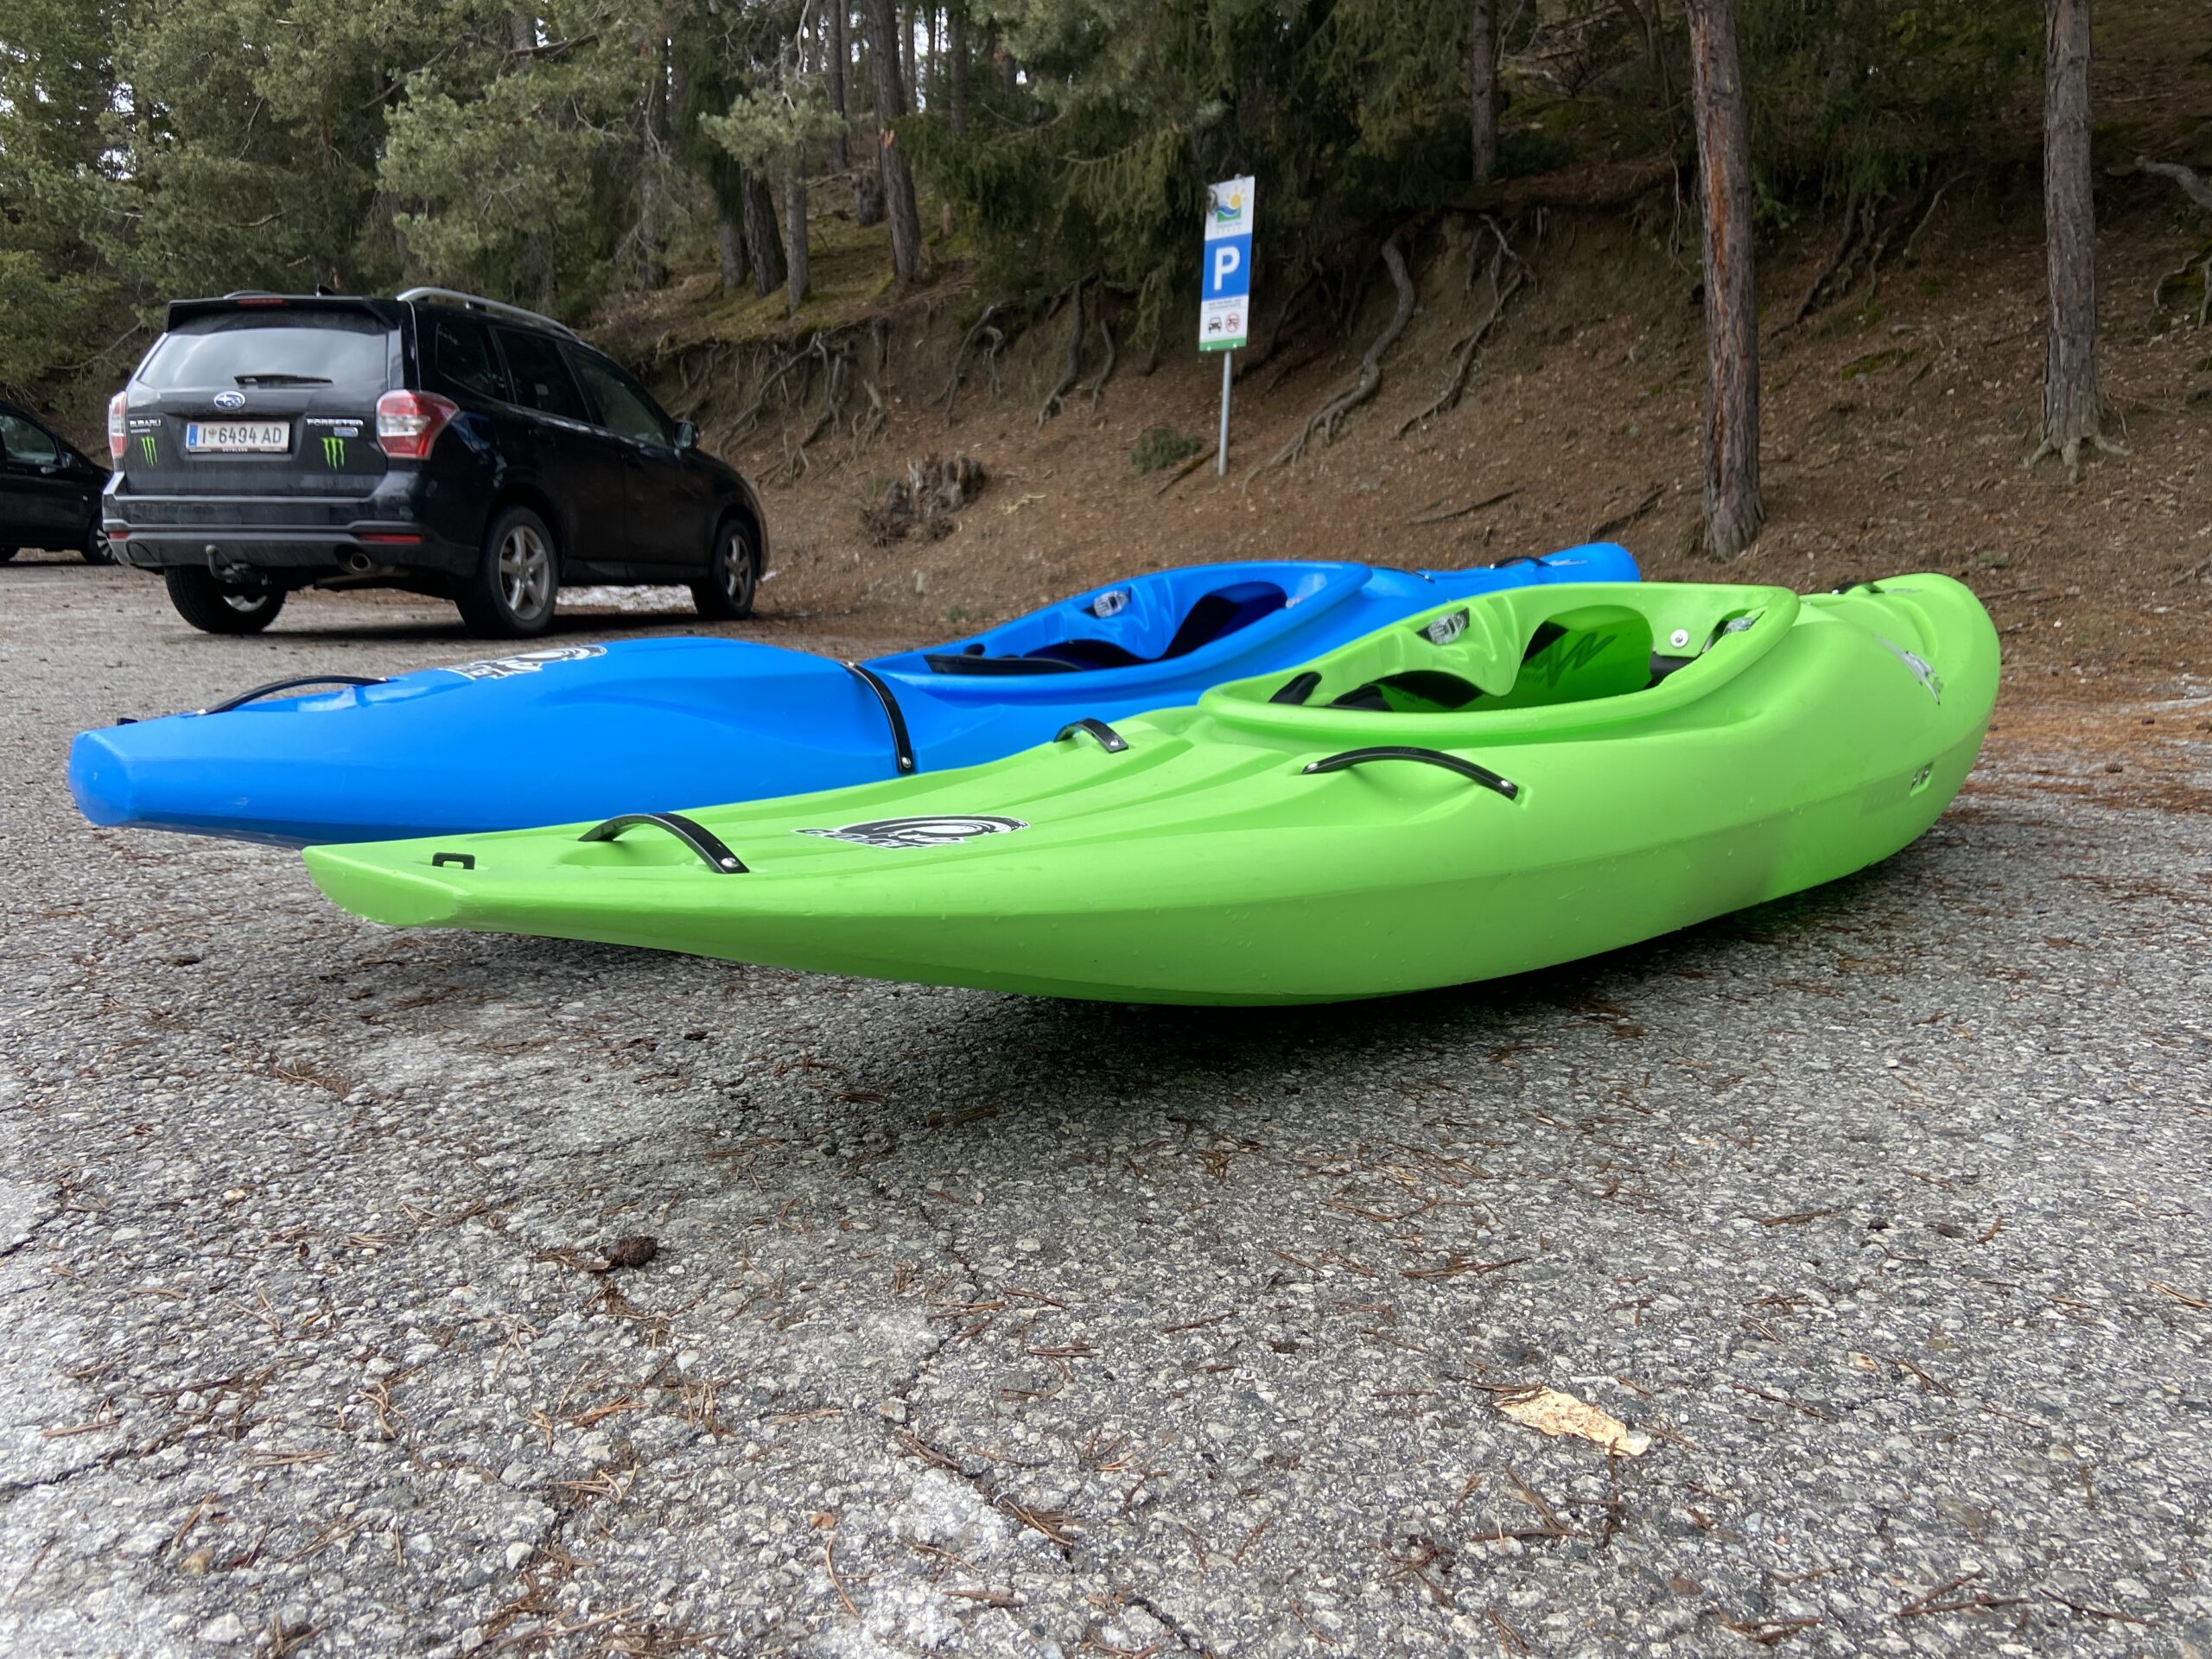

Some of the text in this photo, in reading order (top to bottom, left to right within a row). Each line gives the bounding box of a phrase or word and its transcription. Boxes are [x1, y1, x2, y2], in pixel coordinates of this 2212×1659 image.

[1214, 246, 1240, 290] P
[306, 418, 363, 427] FORESTER
[219, 427, 257, 444] 6494
[261, 427, 282, 443] AD
